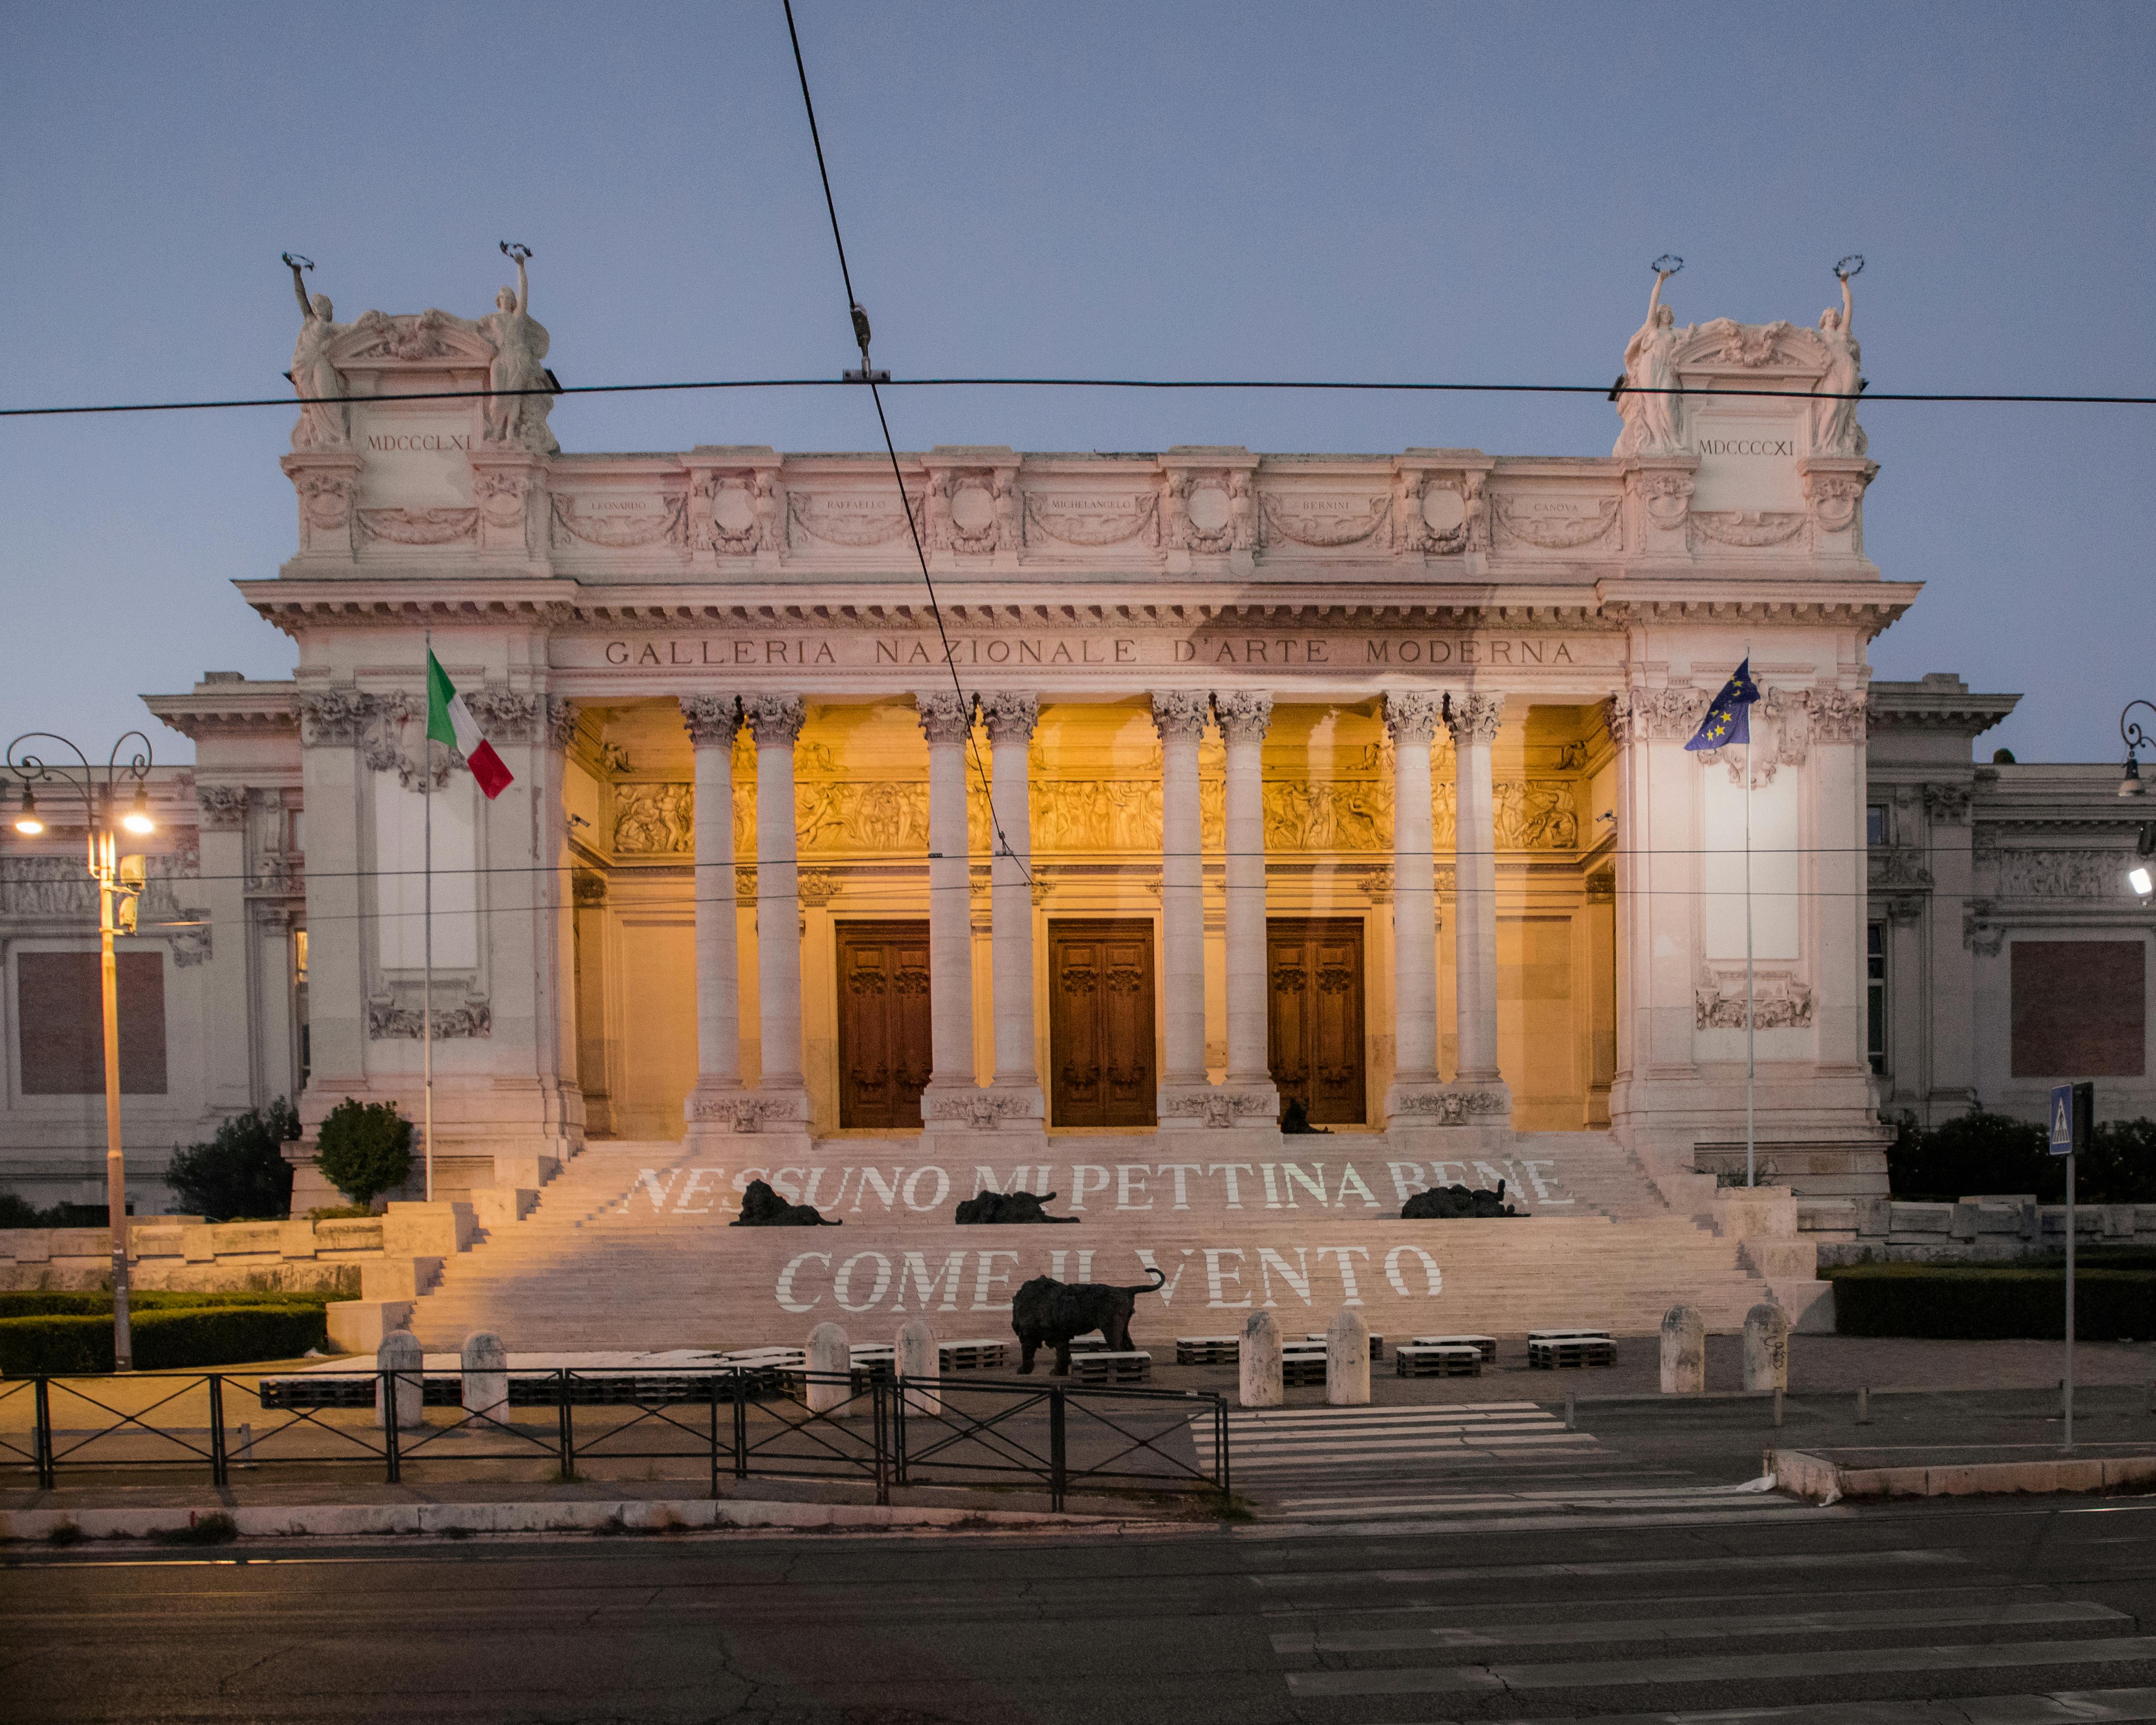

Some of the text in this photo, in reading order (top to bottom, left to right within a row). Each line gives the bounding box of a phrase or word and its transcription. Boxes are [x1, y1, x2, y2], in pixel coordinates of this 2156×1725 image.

[368, 435, 470, 450] MDCCCLXI
[1699, 440, 1793, 456] MDCCCCXI
[1303, 501, 1349, 509] BERNINI
[606, 637, 1574, 665] GALLERIA NAZIONALE D'ARTE MODERNA
[617, 1165, 950, 1213] NESSUNO
[972, 1165, 1053, 1211] MI
[1068, 1161, 1382, 1211] PETTINA
[775, 1251, 1019, 1313] COME
[1134, 1245, 1443, 1309] VENTO
